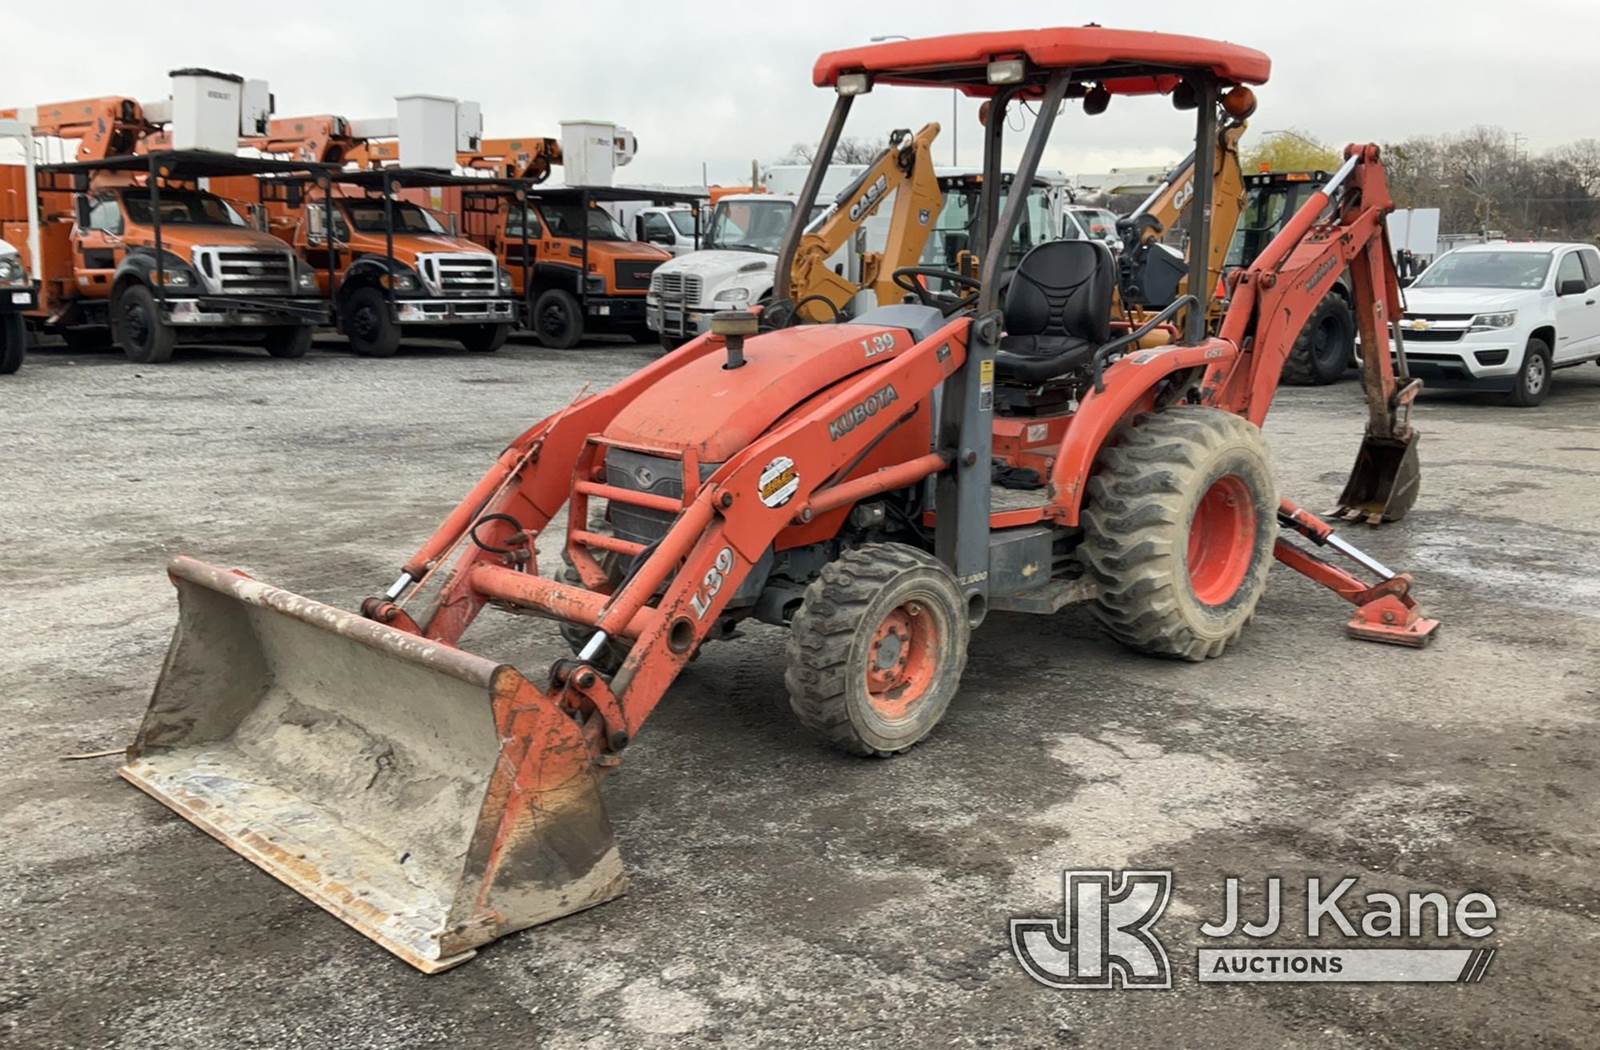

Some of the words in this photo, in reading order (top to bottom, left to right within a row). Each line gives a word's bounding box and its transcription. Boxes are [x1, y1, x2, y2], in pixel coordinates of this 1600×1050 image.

[849, 172, 888, 222] CASE
[1173, 173, 1195, 210] CA
[861, 332, 897, 358] L39
[828, 383, 900, 441] KUBOTA
[689, 546, 734, 620] L39
